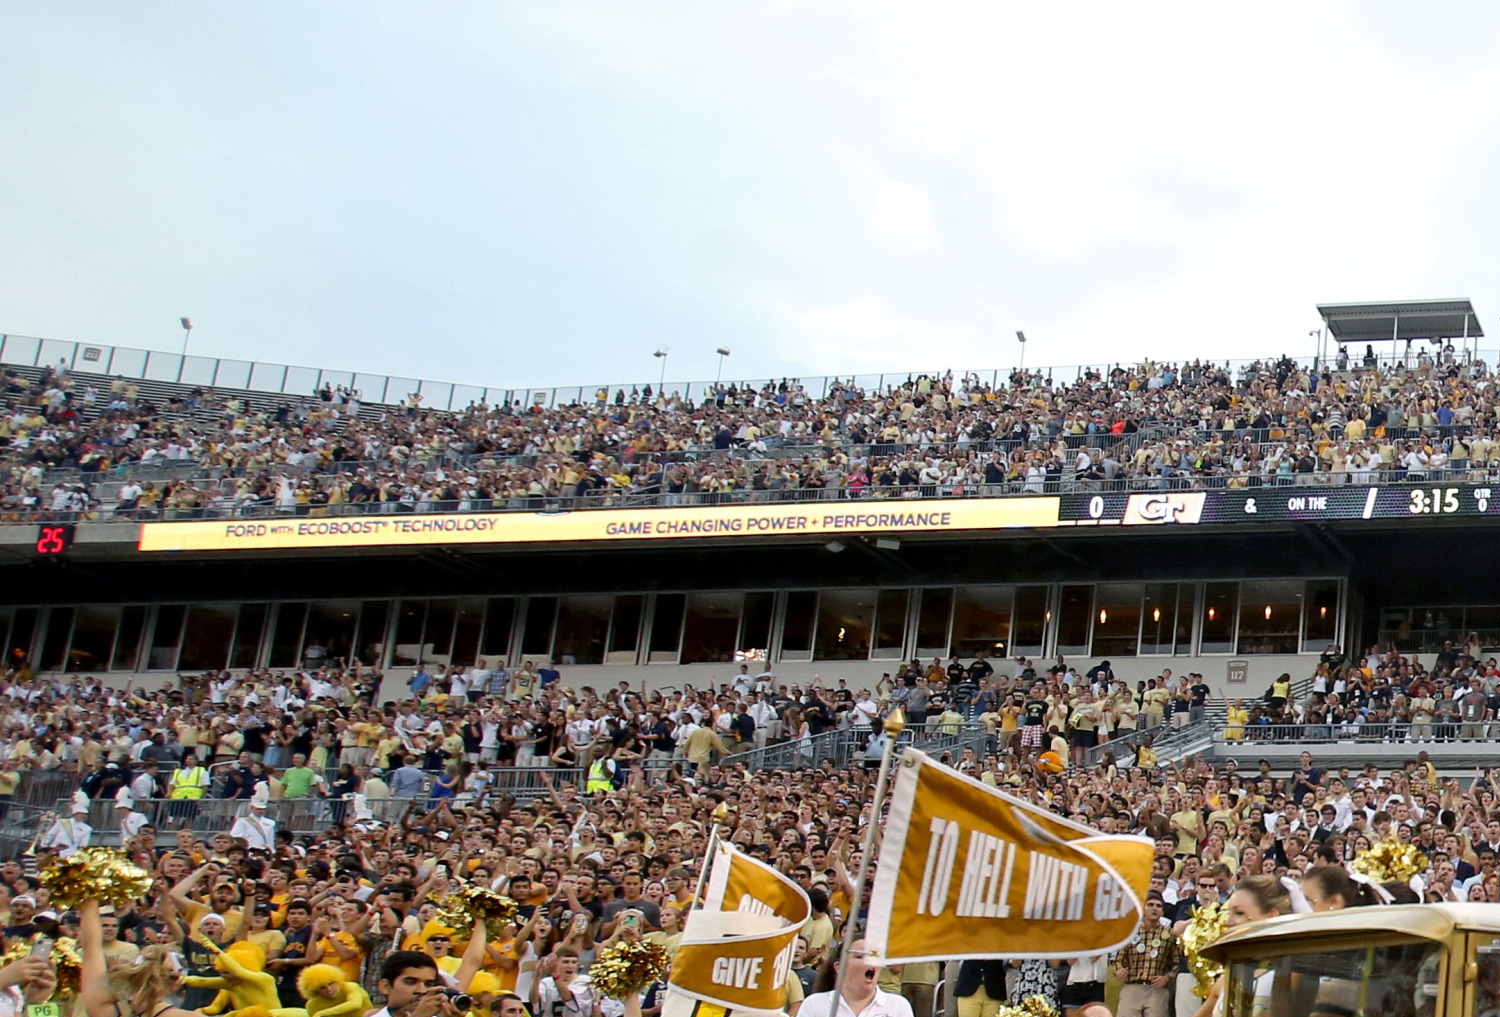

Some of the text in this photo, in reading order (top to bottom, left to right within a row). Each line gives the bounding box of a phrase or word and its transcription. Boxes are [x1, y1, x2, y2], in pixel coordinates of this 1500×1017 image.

[1288, 497, 1327, 511] ON THE
[1409, 488, 1459, 514] 3:15
[1474, 488, 1491, 499] QTR
[1089, 496, 1104, 518] 0
[226, 524, 267, 538] FORD
[270, 526, 294, 535] WITH
[393, 517, 498, 533] TECHNOLOGY
[606, 521, 652, 535] GAME
[656, 518, 742, 534] CHANGING
[746, 516, 807, 531] POWER
[823, 512, 951, 528] PERFORMANCE
[36, 527, 65, 554] 25
[1231, 671, 1244, 680] 117
[916, 816, 960, 917] TO
[955, 829, 1018, 918] HELL
[1023, 850, 1089, 921] WITH
[712, 956, 764, 990] GIVE
[34, 1005, 52, 1017] PG
